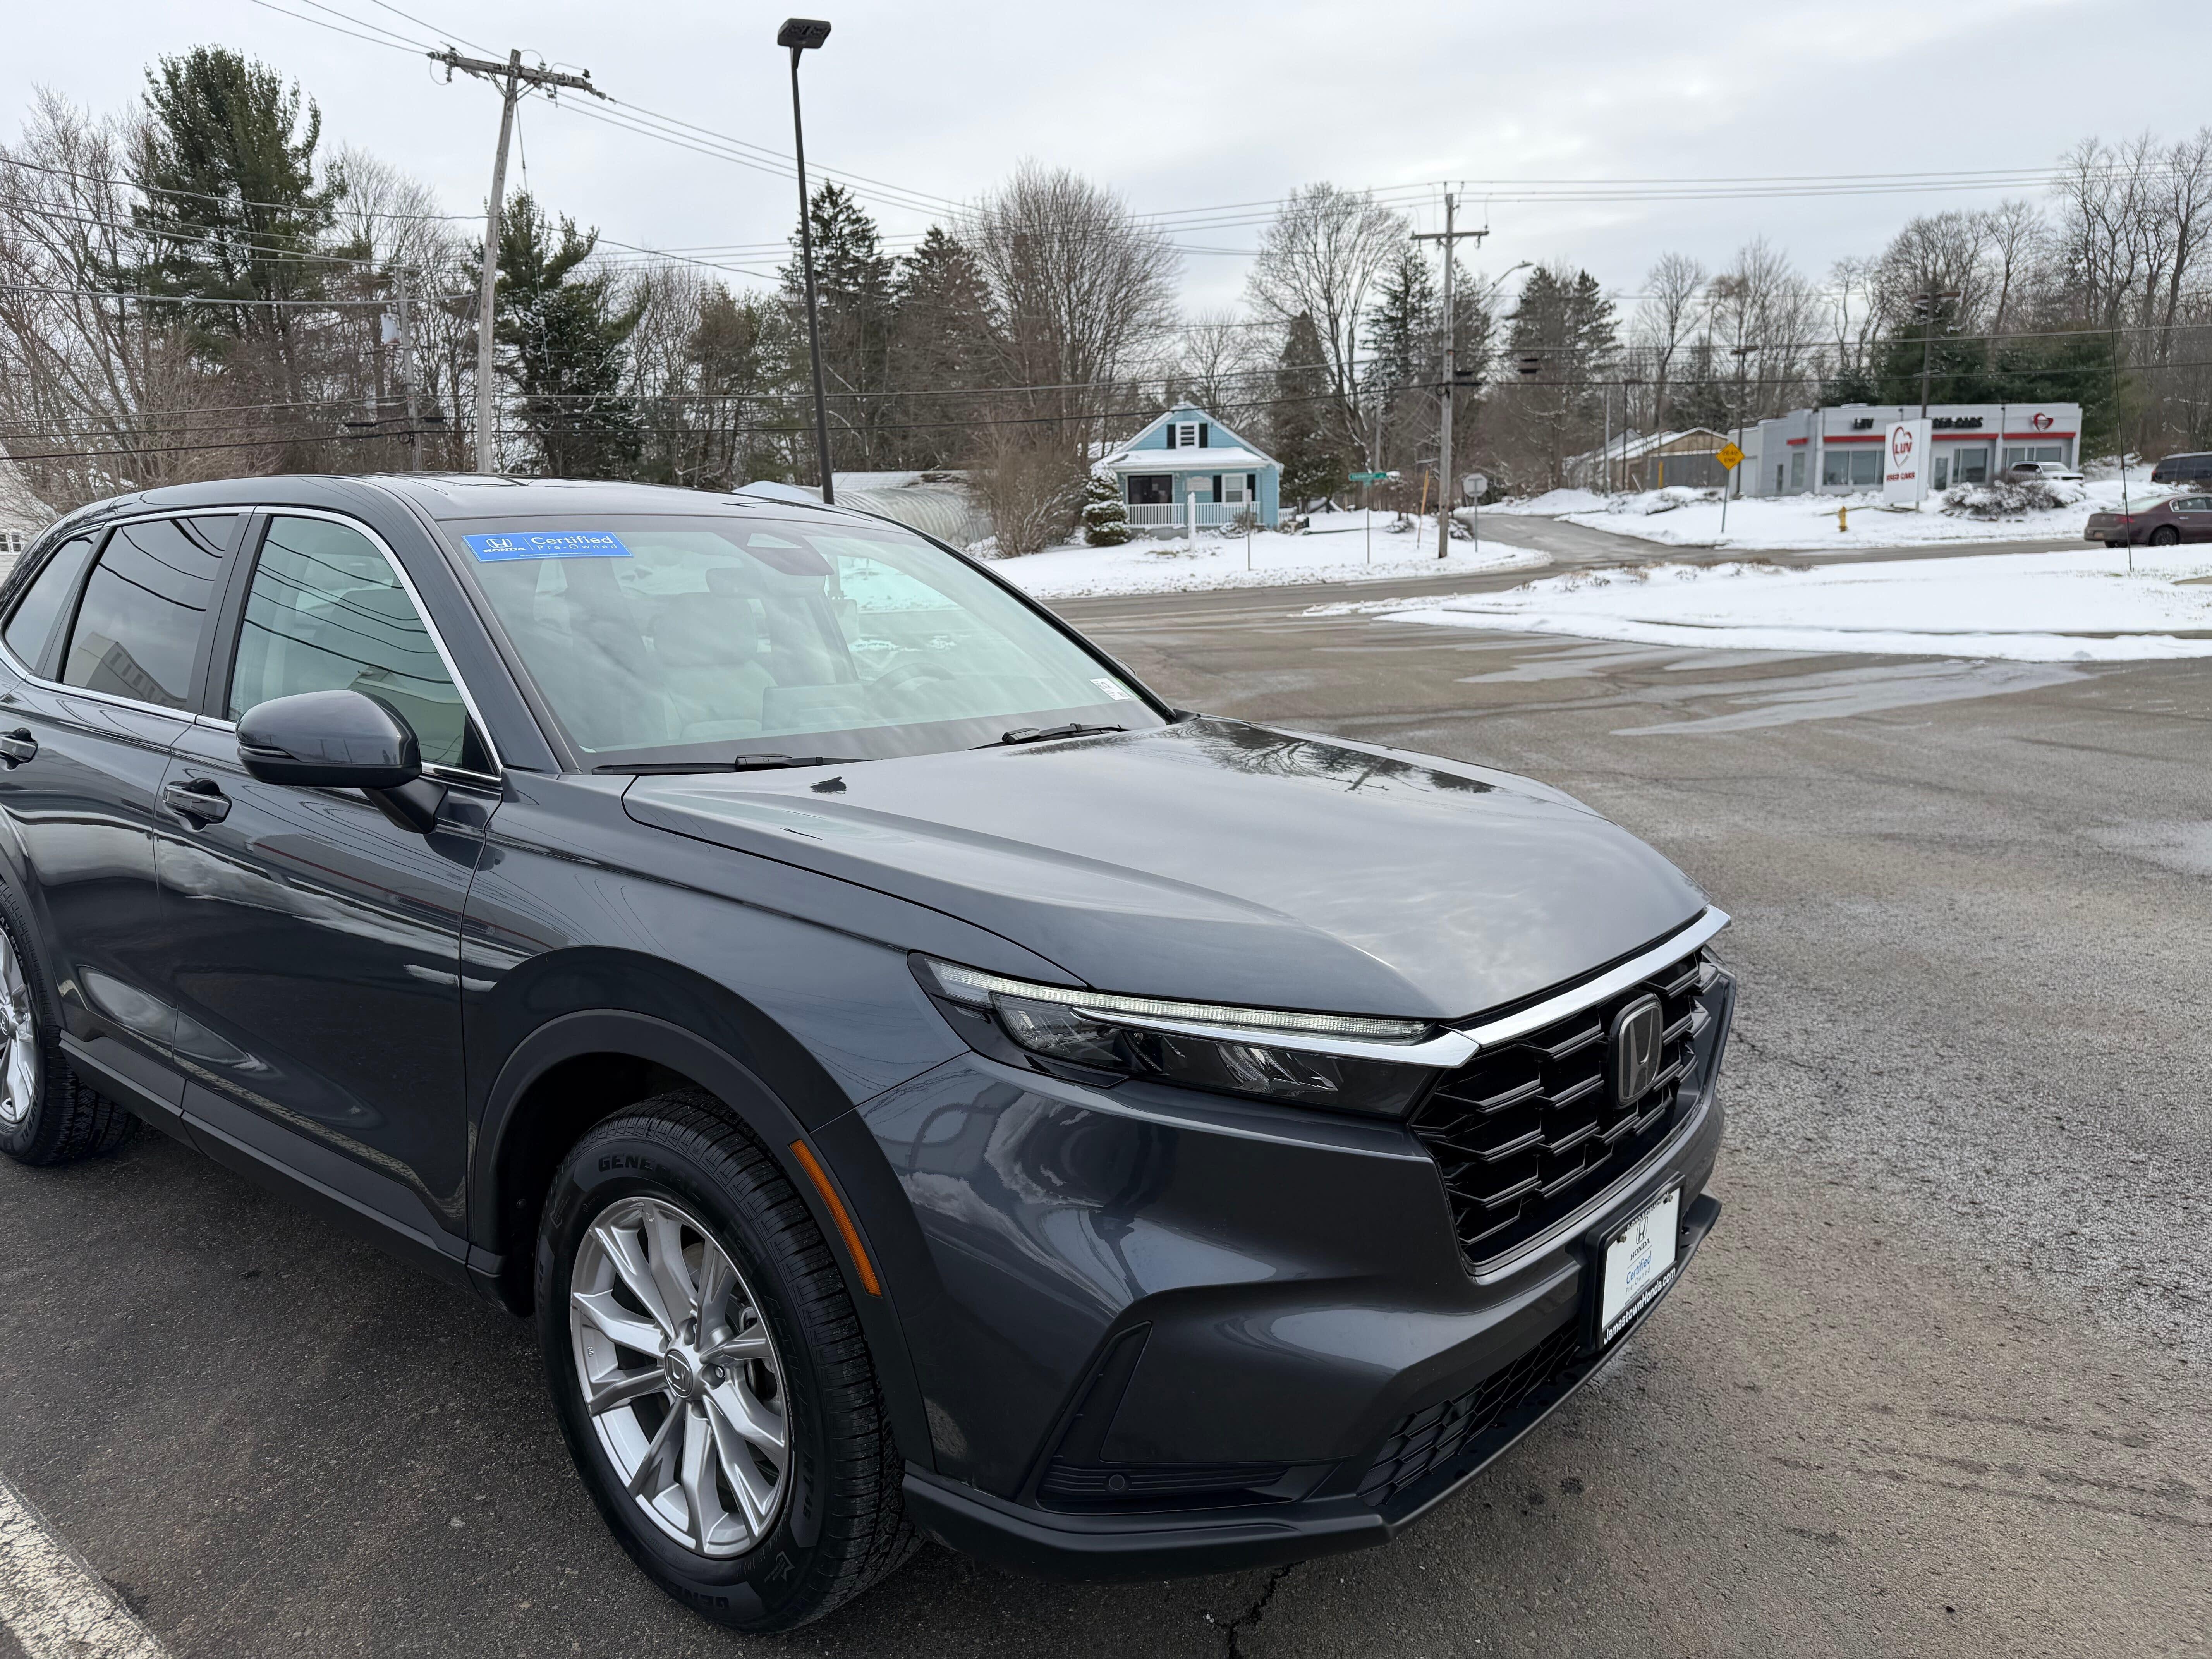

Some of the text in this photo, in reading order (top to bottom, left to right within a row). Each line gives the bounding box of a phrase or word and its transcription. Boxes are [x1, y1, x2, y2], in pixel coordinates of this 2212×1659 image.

[1894, 442, 1912, 454] LUV
[531, 536, 613, 545] Certified
[1630, 1238, 1650, 1261] HONDA
[1626, 1250, 1652, 1284] Certified
[1626, 1265, 1650, 1295] Pre-Owned
[1604, 1267, 1676, 1345] JamestownHonda.com
